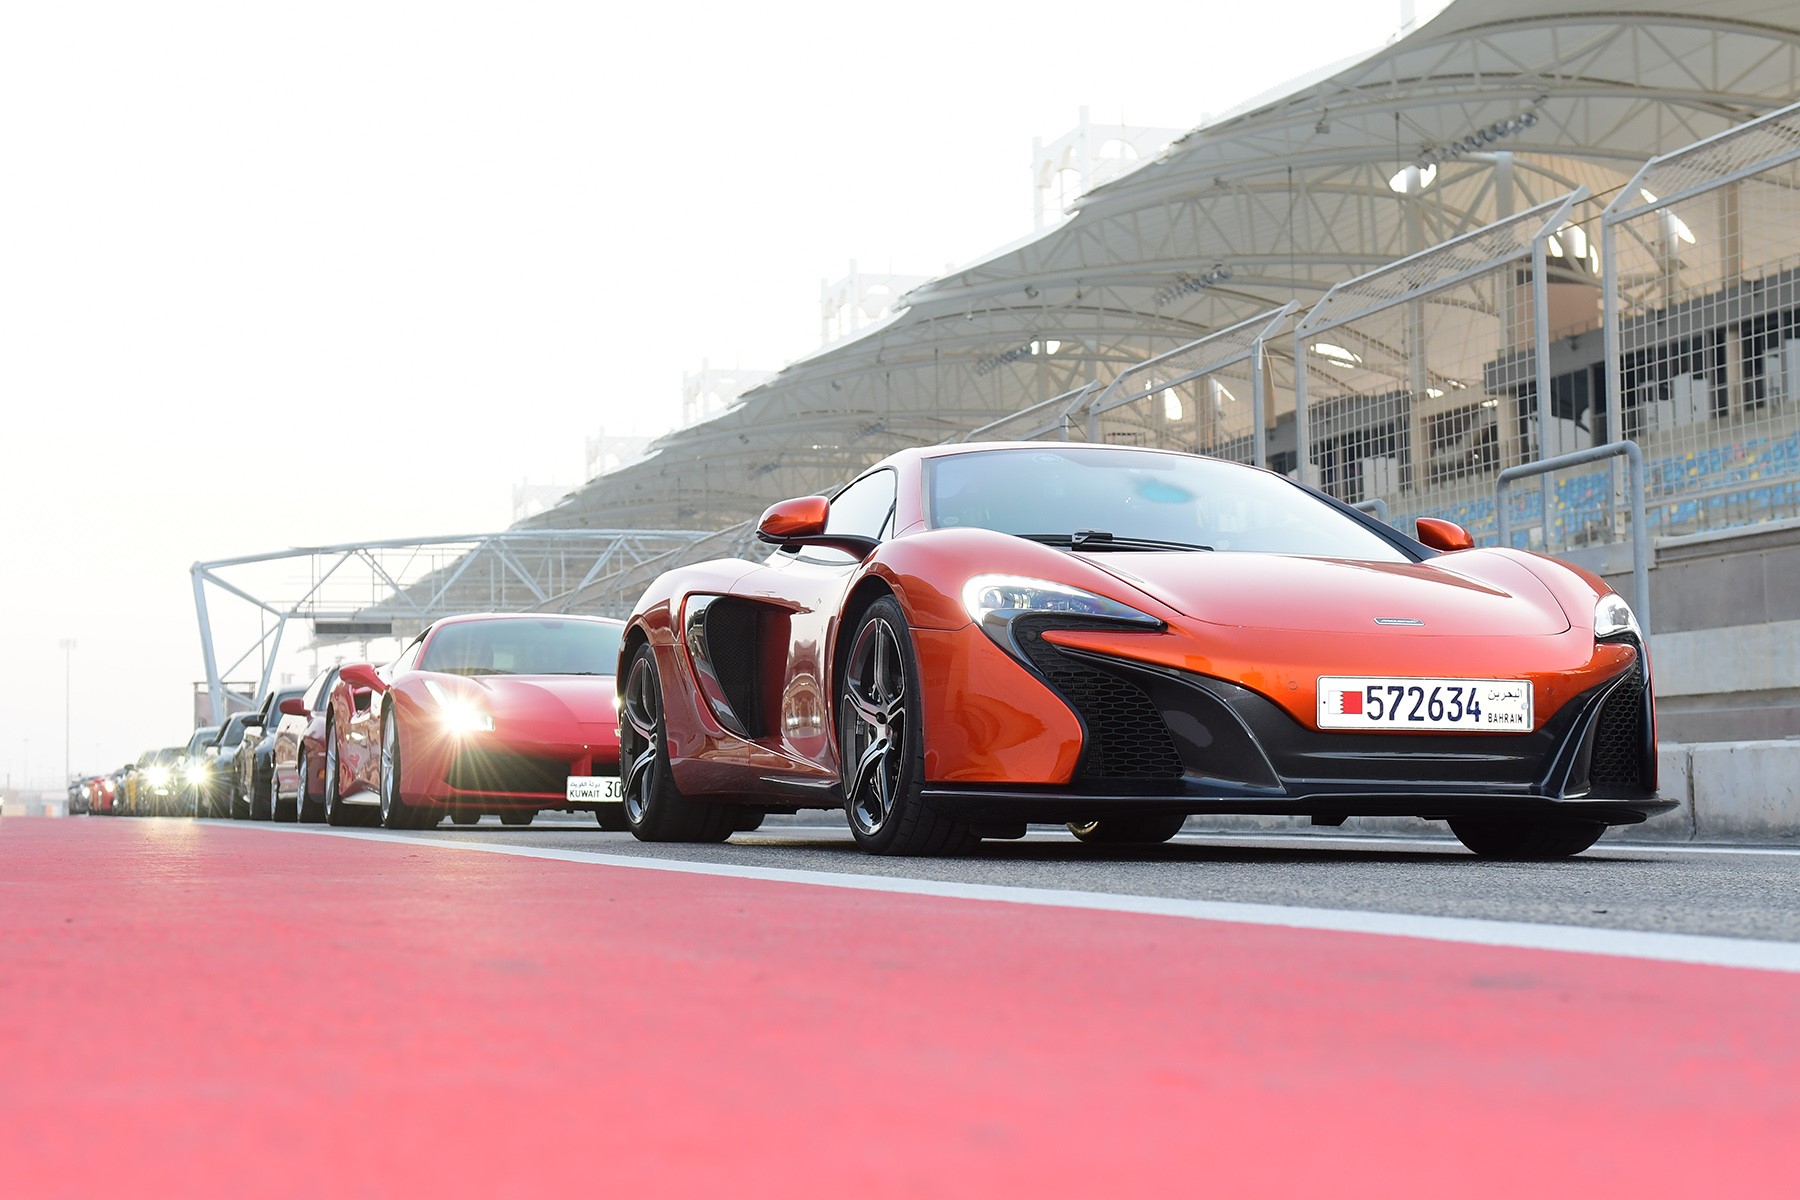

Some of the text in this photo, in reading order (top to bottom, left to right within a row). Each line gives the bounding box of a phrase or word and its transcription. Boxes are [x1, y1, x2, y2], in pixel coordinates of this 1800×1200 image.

[1488, 688, 1522, 702] البحرين
[1366, 686, 1482, 722] 572634
[1488, 713, 1522, 723] BAHRAIN
[570, 790, 600, 798] KUWAIT
